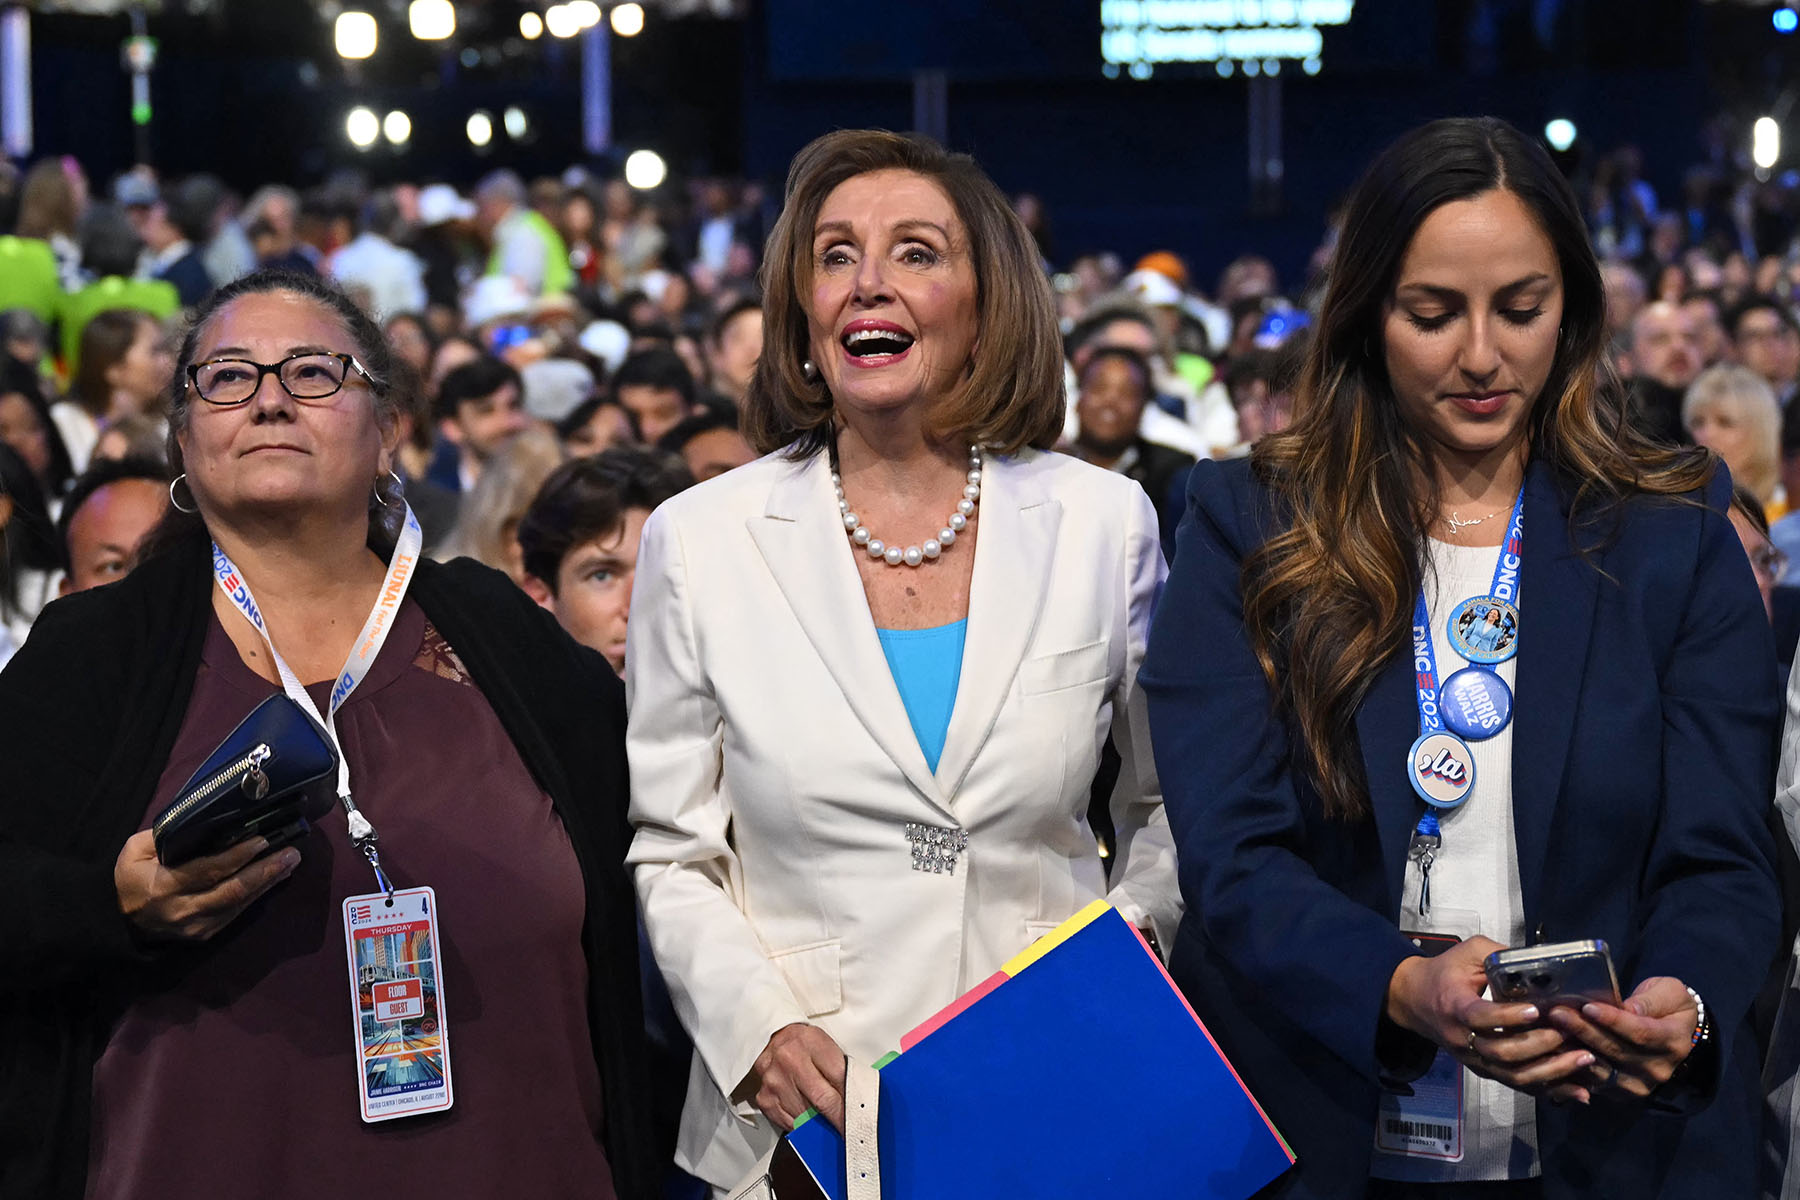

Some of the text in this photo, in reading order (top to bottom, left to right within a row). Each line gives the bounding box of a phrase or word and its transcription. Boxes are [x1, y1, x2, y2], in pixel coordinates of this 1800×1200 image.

[1494, 553, 1520, 600] DNC
[233, 586, 263, 629] DNC
[1413, 626, 1439, 731] DNC 202
[1454, 687, 1480, 727] WALZ
[1466, 671, 1502, 730] HARRIS
[421, 897, 429, 914] 4
[371, 923, 412, 935] THURSDAY
[388, 984, 407, 998] FLOOR
[390, 1001, 408, 1015] GUEST
